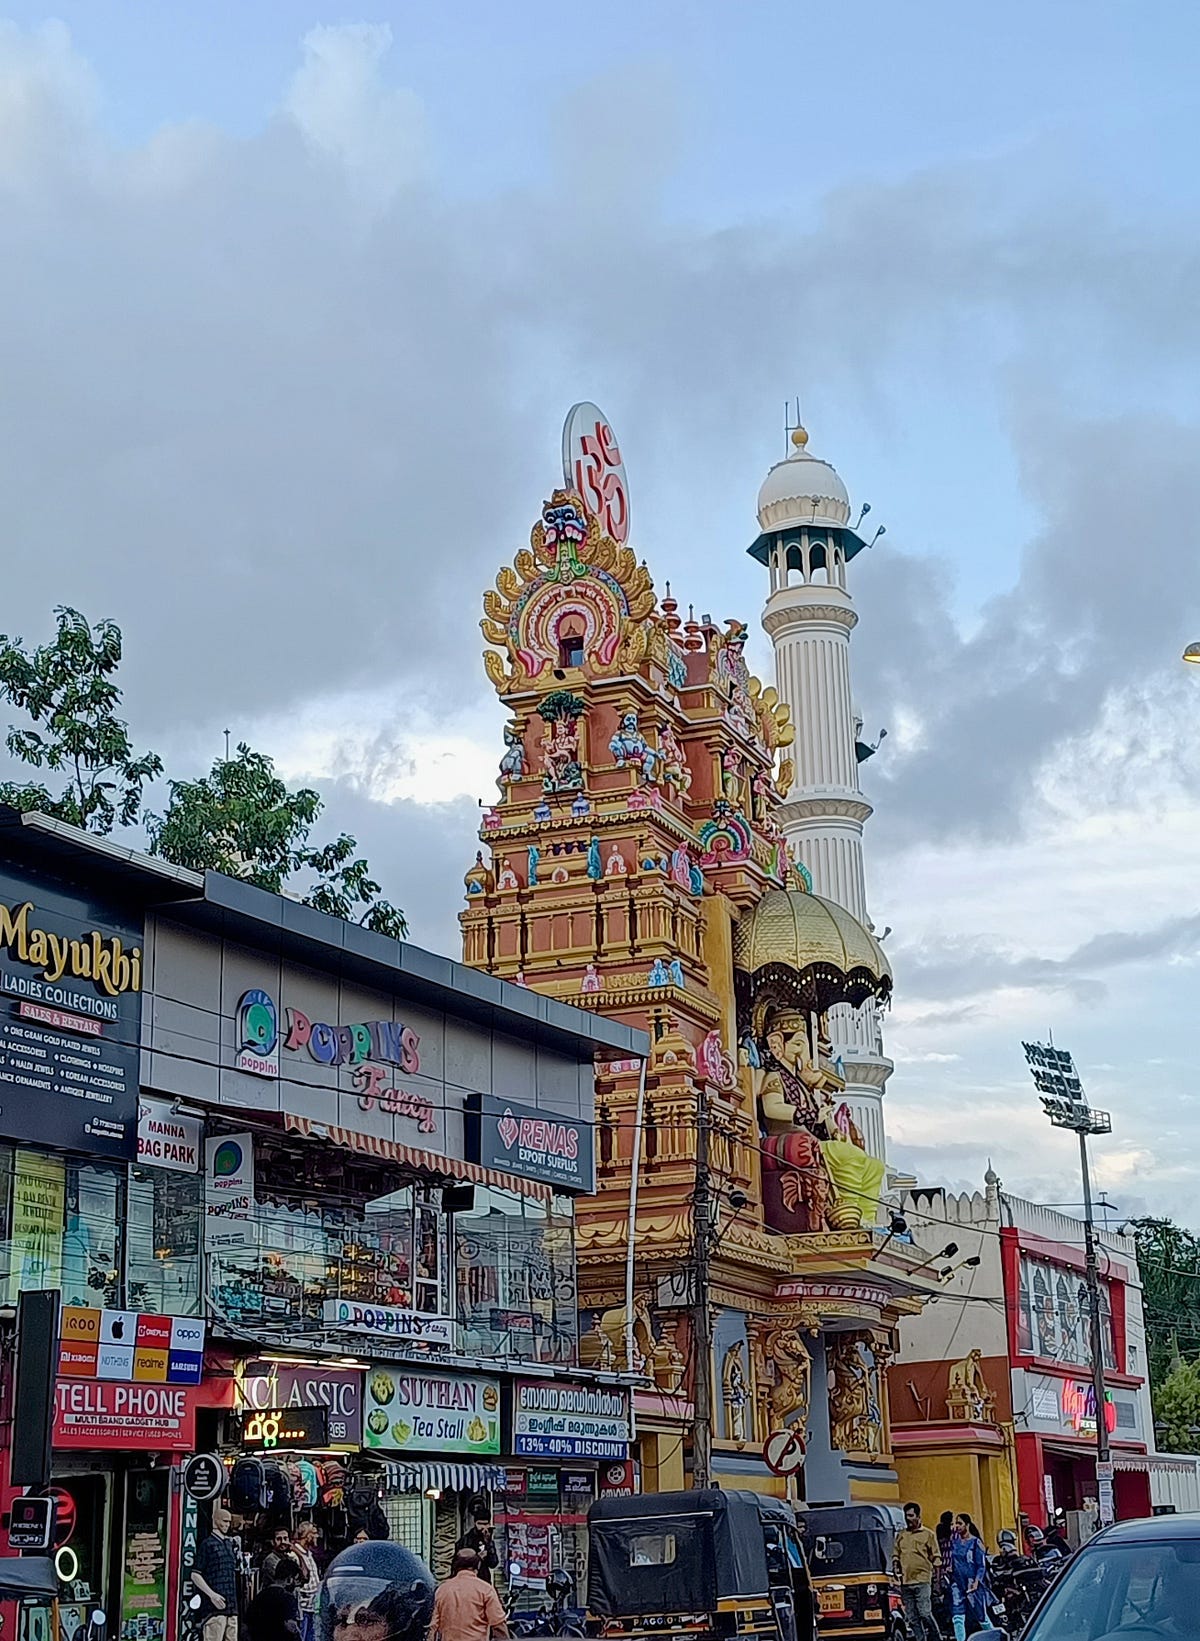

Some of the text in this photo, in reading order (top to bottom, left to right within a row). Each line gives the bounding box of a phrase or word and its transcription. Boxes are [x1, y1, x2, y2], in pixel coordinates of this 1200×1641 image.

[0, 902, 141, 996] Mayukhi
[4, 974, 118, 1019] LADIES COLLECTIONS
[24, 1006, 100, 1033] SALES & RENTALS
[43, 1034, 60, 1046] GOLD
[284, 1007, 420, 1075] POPPINS
[241, 1056, 277, 1074] poppins
[148, 1121, 186, 1139] MANNA
[518, 1118, 579, 1160] RENAS
[137, 1138, 195, 1165] BAG PARK
[519, 1148, 578, 1173] EXPORT SURPLUS
[207, 1196, 249, 1217] POPPINS
[65, 1317, 95, 1331] iQOO
[353, 1306, 423, 1335] POPPINS
[137, 1358, 165, 1369] realme
[171, 1362, 198, 1372] SAMSUNG
[57, 1384, 186, 1417] TELL PHONE
[399, 1375, 477, 1413] SUTHAN
[59, 1427, 77, 1435] SALES
[80, 1428, 119, 1437] ACCESSORIES
[122, 1429, 144, 1438] SERVICE
[75, 1415, 169, 1427] MULTI BRAND GADGET HUB
[412, 1416, 465, 1440] Tea Stall
[574, 1440, 624, 1457] DISCOUNT
